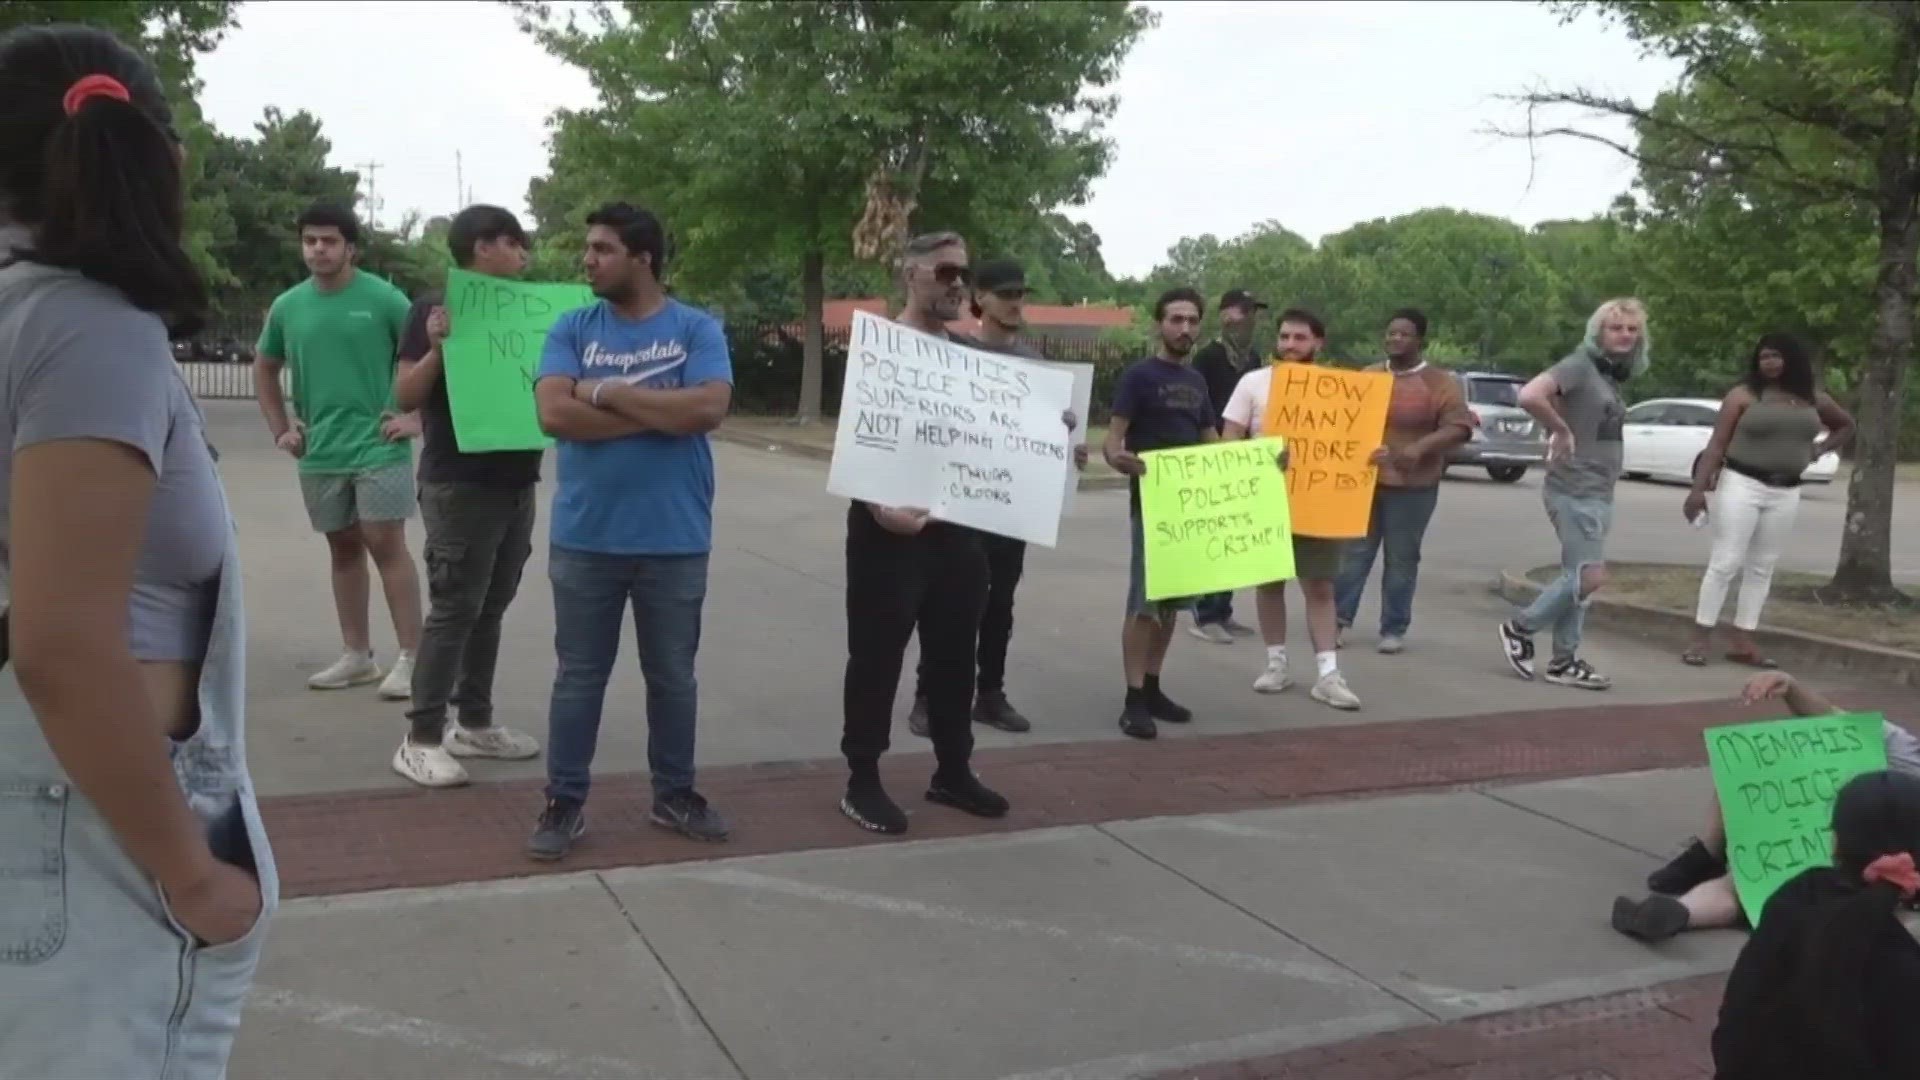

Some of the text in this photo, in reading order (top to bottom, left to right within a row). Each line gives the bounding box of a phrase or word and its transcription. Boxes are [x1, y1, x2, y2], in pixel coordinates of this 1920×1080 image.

[458, 280, 552, 321] MPD
[859, 317, 1031, 396] MEMPHIS
[860, 350, 1024, 409] POLICE DEPT
[1285, 369, 1376, 402] HOW
[855, 380, 976, 423] SUPERIORS
[1275, 404, 1362, 433] MANY
[855, 410, 1065, 461] NOT HELPING CITIZENS
[1287, 437, 1361, 467] MORE
[1178, 475, 1261, 513] POLICE
[1155, 511, 1253, 546] SUPPORTS
[1716, 725, 1864, 774] MEMPHIS
[1738, 768, 1841, 815] POLICE
